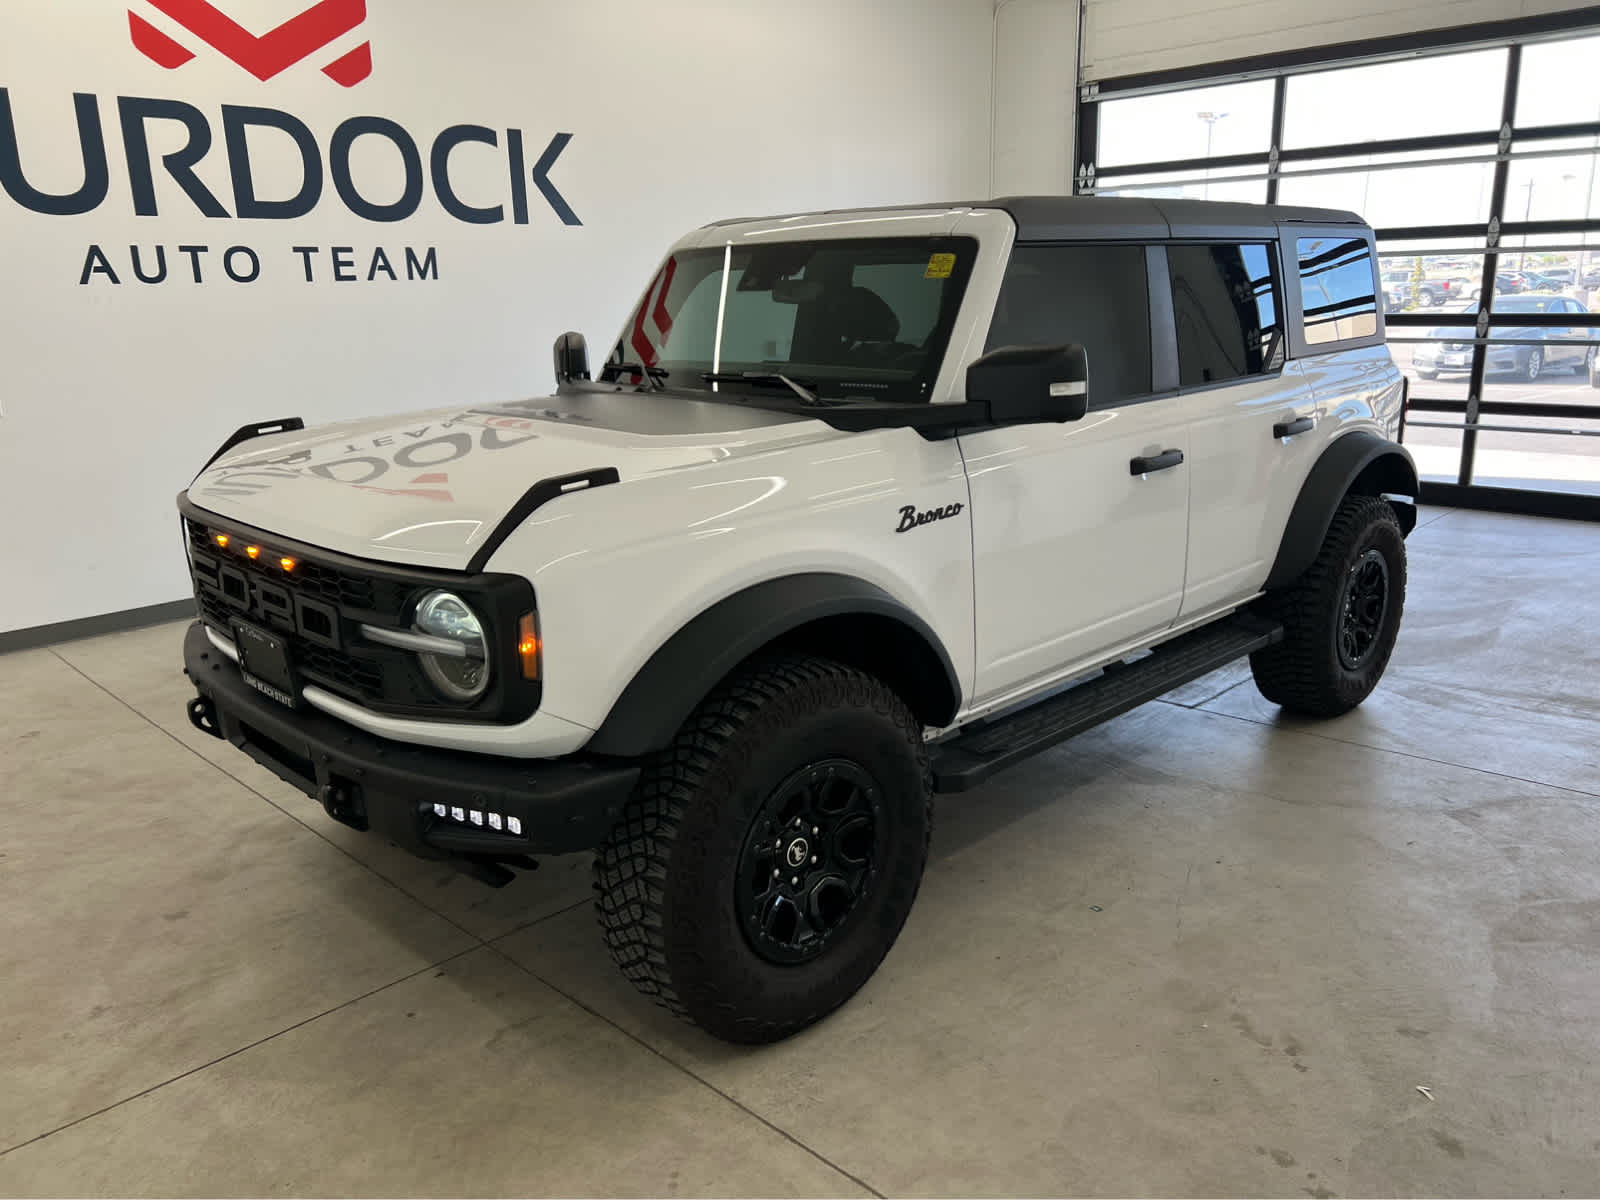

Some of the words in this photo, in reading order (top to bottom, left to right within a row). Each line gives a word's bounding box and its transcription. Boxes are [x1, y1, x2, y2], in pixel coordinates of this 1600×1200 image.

[79, 244, 261, 285] AUTO
[292, 246, 440, 282] TEAM
[895, 502, 965, 533] Bronco
[193, 553, 341, 650] FORD
